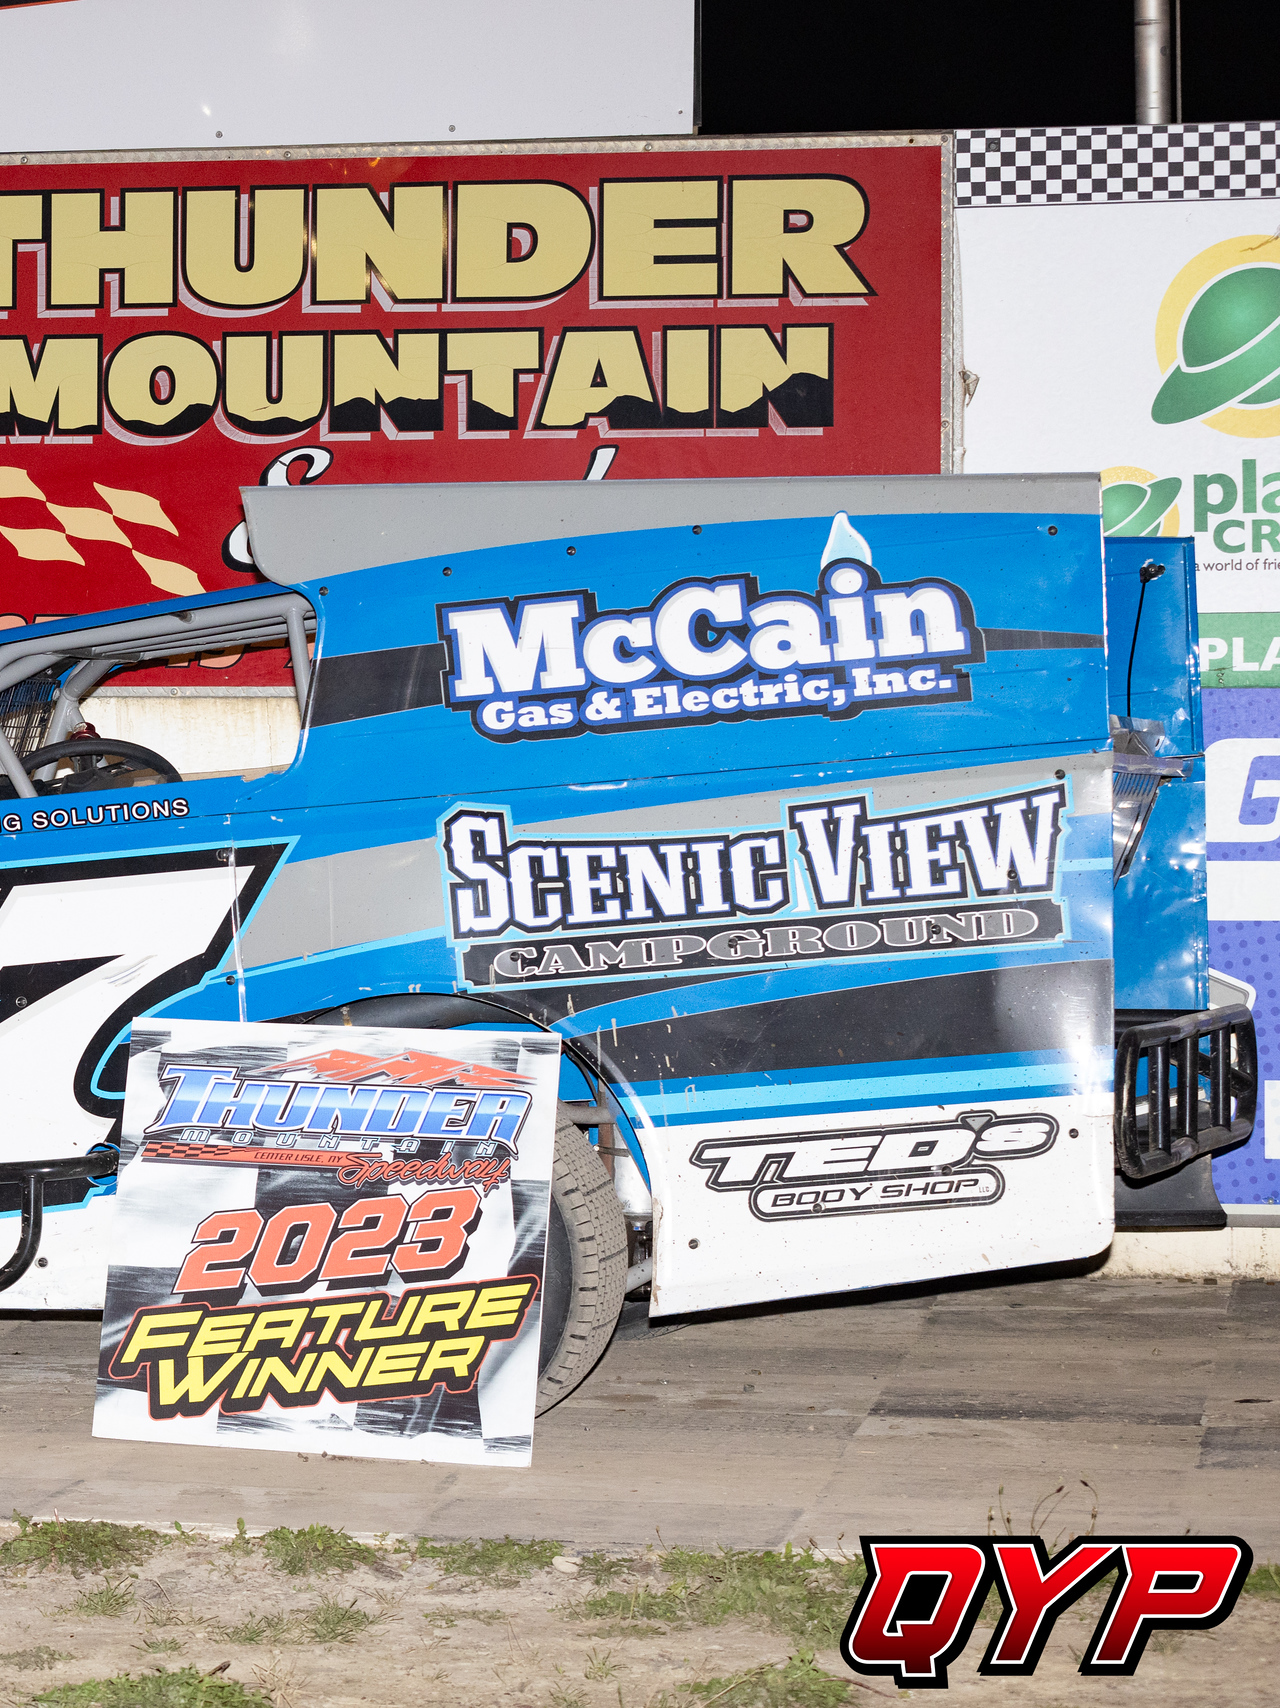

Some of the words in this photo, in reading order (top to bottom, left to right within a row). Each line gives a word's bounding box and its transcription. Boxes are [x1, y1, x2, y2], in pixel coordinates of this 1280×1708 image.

[1203, 558, 1243, 571] world
[1248, 558, 1260, 571] of
[447, 567, 968, 698] McCain
[481, 697, 577, 732] Gas
[586, 692, 621, 722] &
[625, 673, 848, 719] Electric,
[852, 667, 954, 697] Inc.
[31, 798, 189, 829] SOLUTIONS
[447, 811, 788, 936] SCENIC
[791, 786, 1065, 908] VIEW
[493, 907, 1039, 979] CAMPGROUND
[143, 1063, 532, 1155] THUNDER
[180, 1127, 497, 1156] MOUNTAIN
[253, 1151, 292, 1162] CENTER
[331, 1155, 346, 1164] NY
[338, 1151, 511, 1192] Speedway
[696, 1113, 1055, 1188] TED'S
[770, 1185, 872, 1208] BODY
[880, 1178, 979, 1199] SHOP
[172, 1187, 482, 1298] 2023
[119, 1281, 533, 1366] FEATURE
[156, 1335, 487, 1407] WINNER
